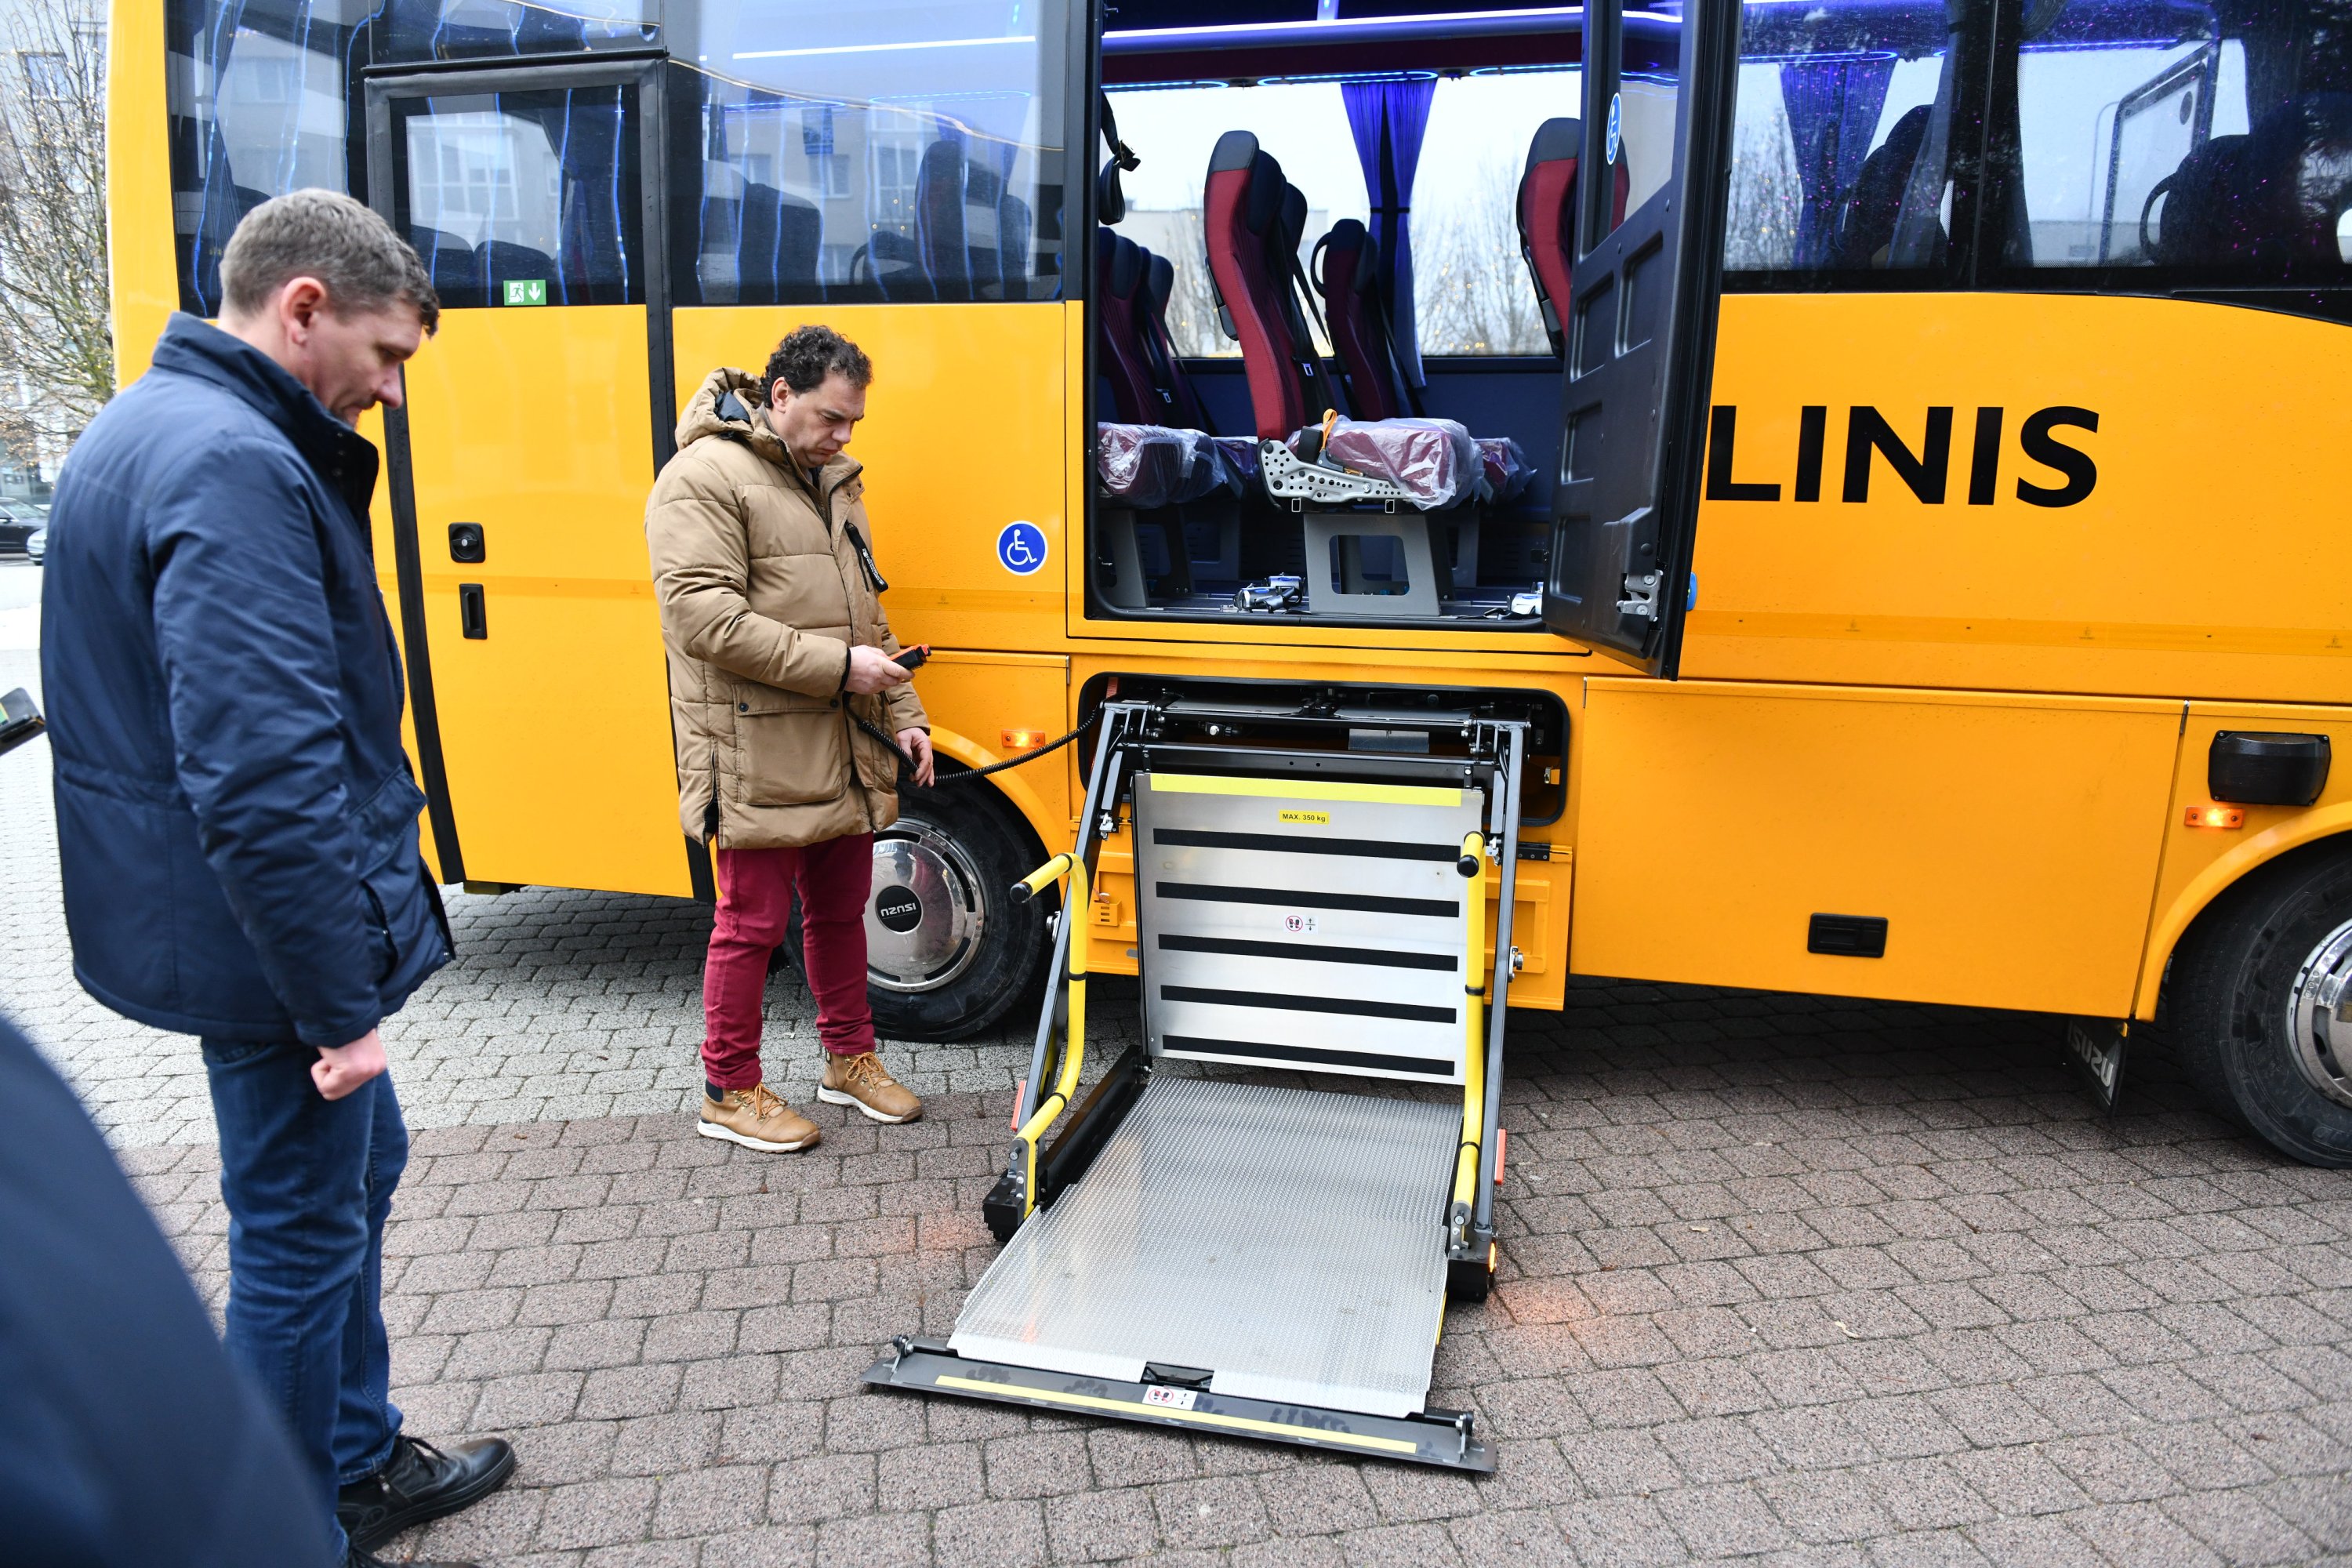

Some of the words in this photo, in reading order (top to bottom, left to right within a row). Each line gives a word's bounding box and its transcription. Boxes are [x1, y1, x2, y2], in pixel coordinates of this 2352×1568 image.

[1705, 405, 2100, 508] LINIS
[880, 902, 916, 916] ISUZU
[2067, 1019, 2114, 1087] ISUZU
